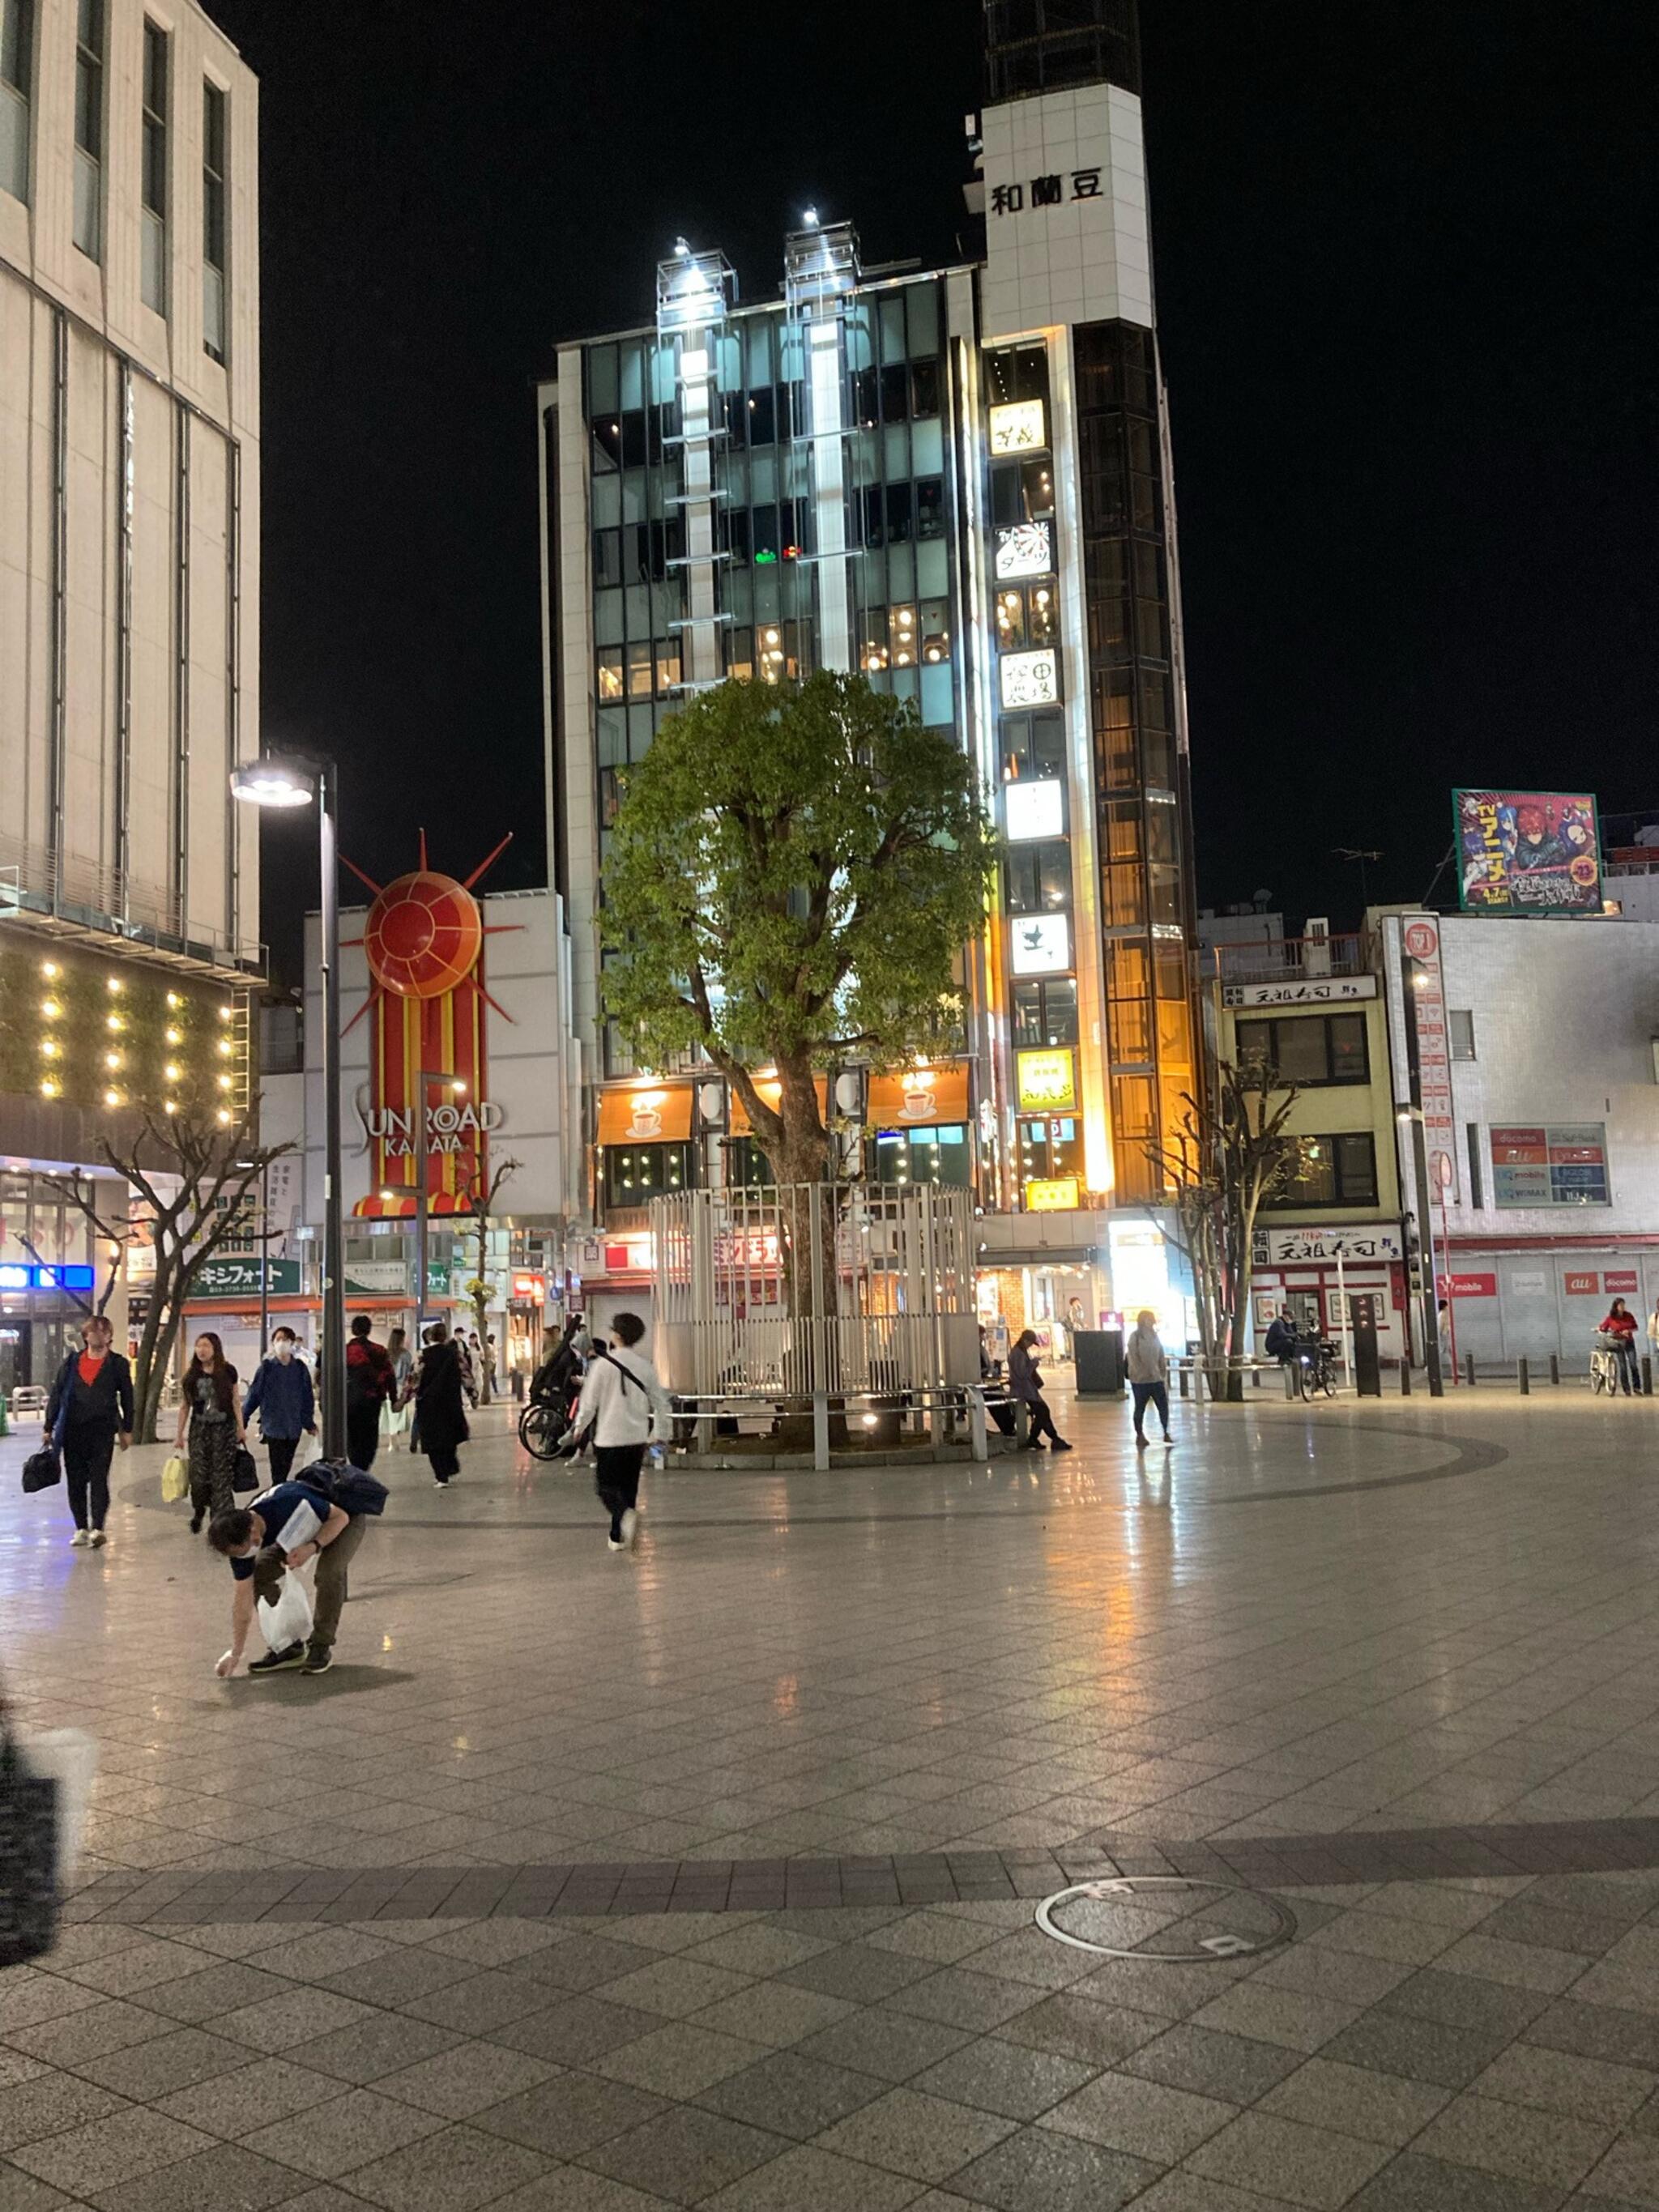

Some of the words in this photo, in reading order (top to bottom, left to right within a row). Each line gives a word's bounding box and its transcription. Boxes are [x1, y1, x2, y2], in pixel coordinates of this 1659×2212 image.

[991, 167, 1104, 216] 和蘭豆
[1256, 986, 1331, 1004] 元祖寿司
[351, 1083, 412, 1157] SUN
[1499, 1133, 1537, 1143] docomo
[1277, 1239, 1376, 1260] 元祖寿司
[200, 1264, 283, 1285] キシフォート
[1571, 1278, 1592, 1289] au
[1606, 1278, 1636, 1288] docomo
